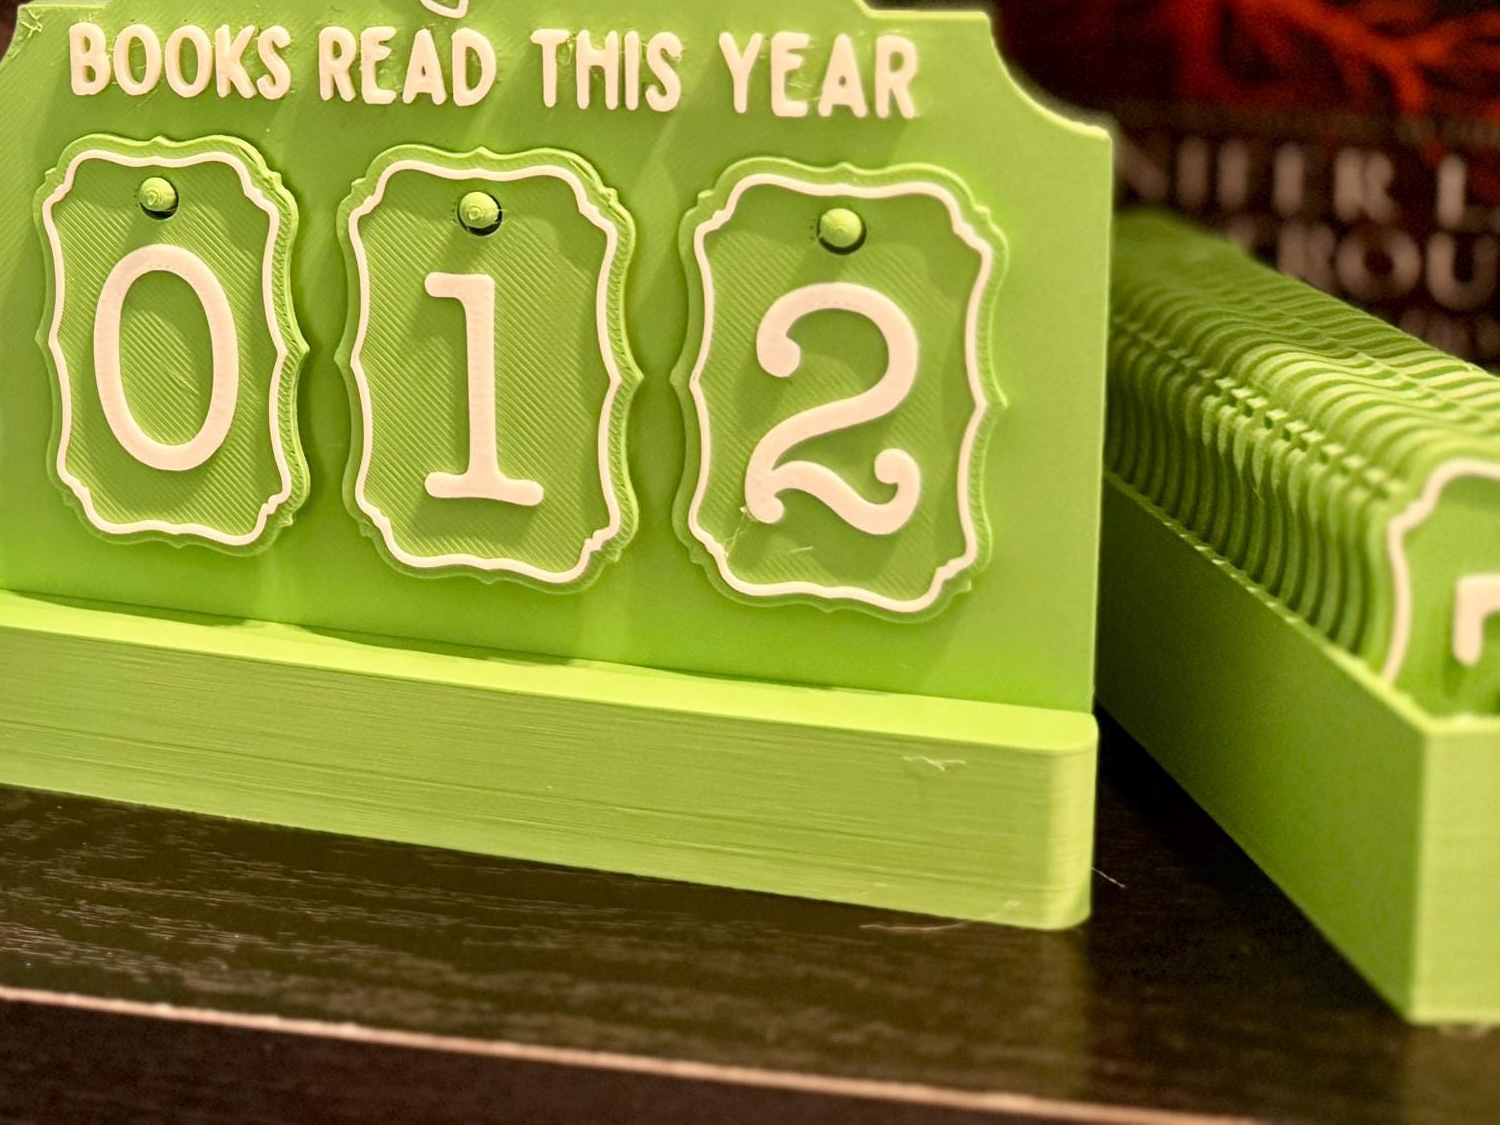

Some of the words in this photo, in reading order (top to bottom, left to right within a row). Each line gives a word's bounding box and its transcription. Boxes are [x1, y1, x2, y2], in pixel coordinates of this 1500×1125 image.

[69, 22, 290, 99] BOOKS
[318, 27, 496, 107] READ
[529, 29, 682, 112] THIS
[719, 30, 918, 119] YEAR
